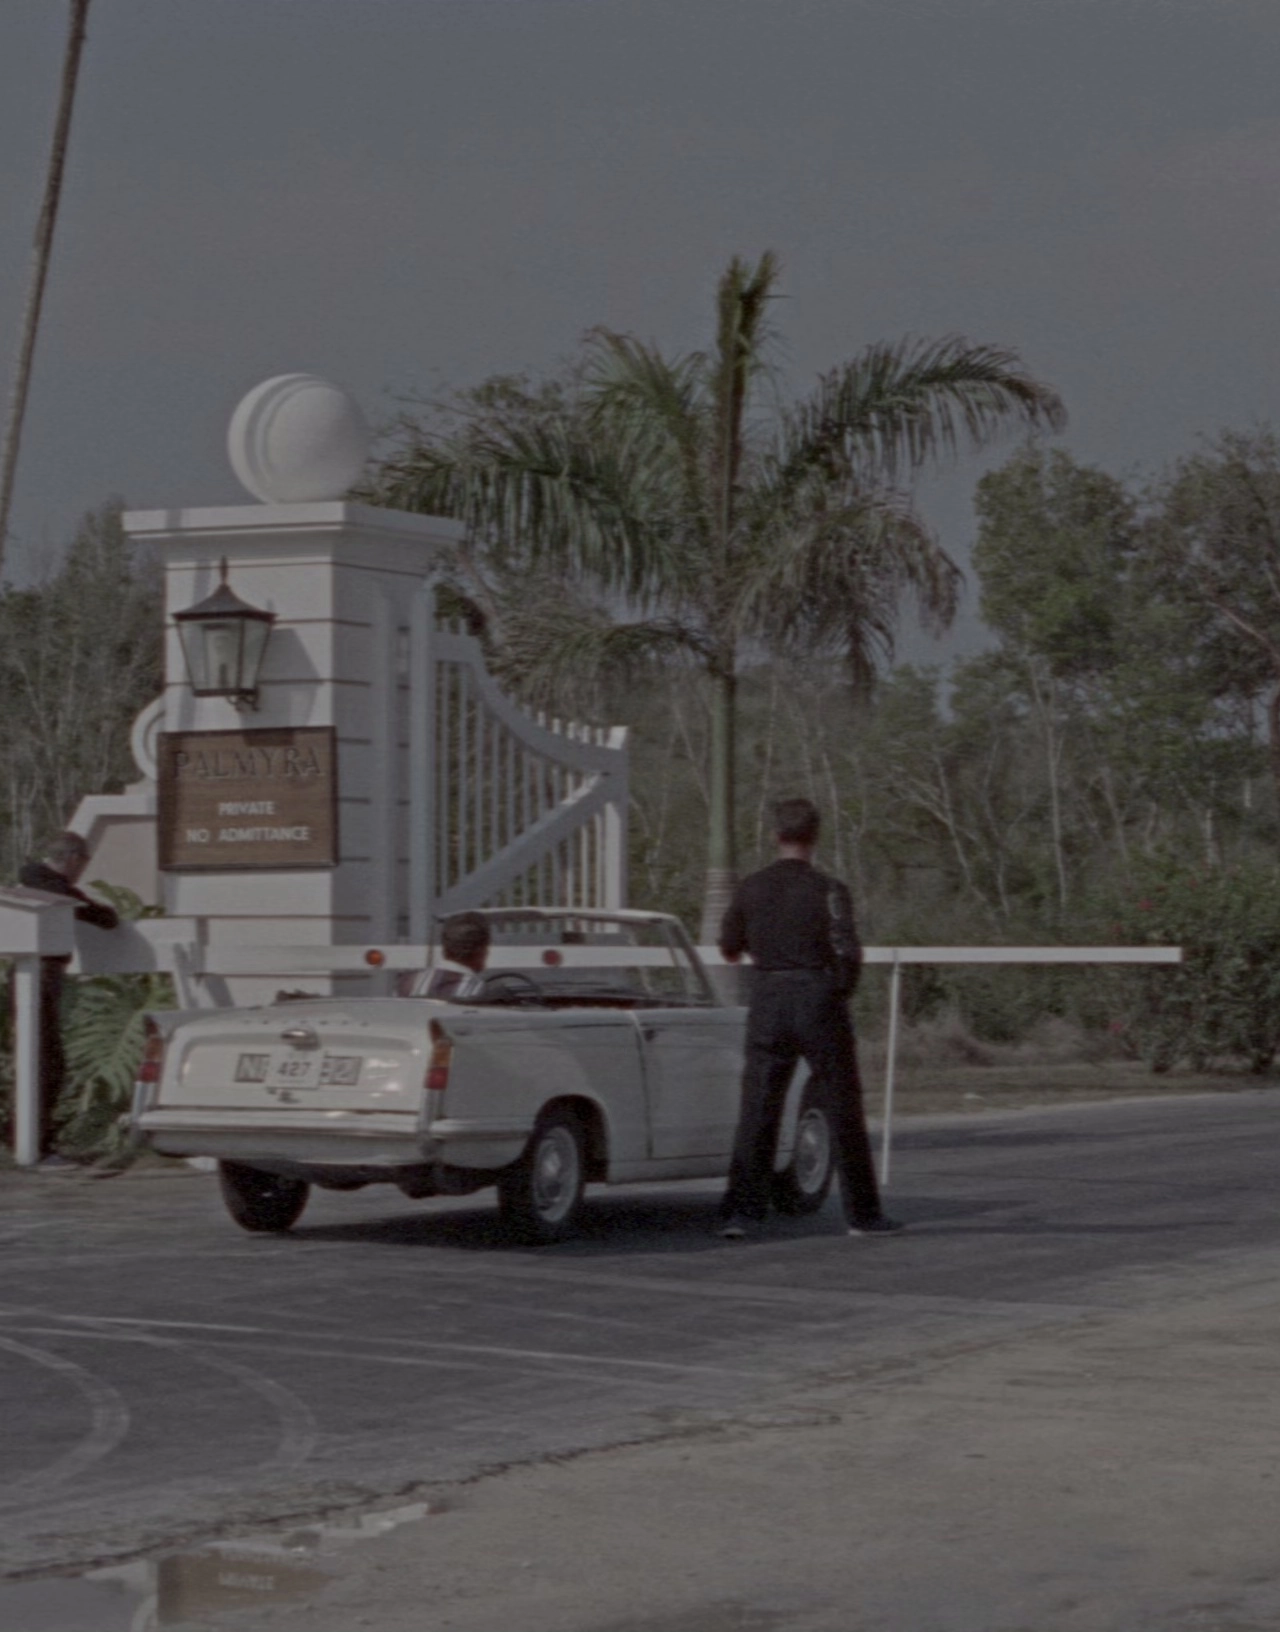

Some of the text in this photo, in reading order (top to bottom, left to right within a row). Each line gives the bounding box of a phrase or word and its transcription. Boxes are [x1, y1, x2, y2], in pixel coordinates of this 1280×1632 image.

[172, 746, 326, 780] PALMYRA
[218, 801, 276, 816] PRIVATE
[186, 826, 311, 843] NO ADMITTANCE
[276, 1061, 312, 1077] 427
